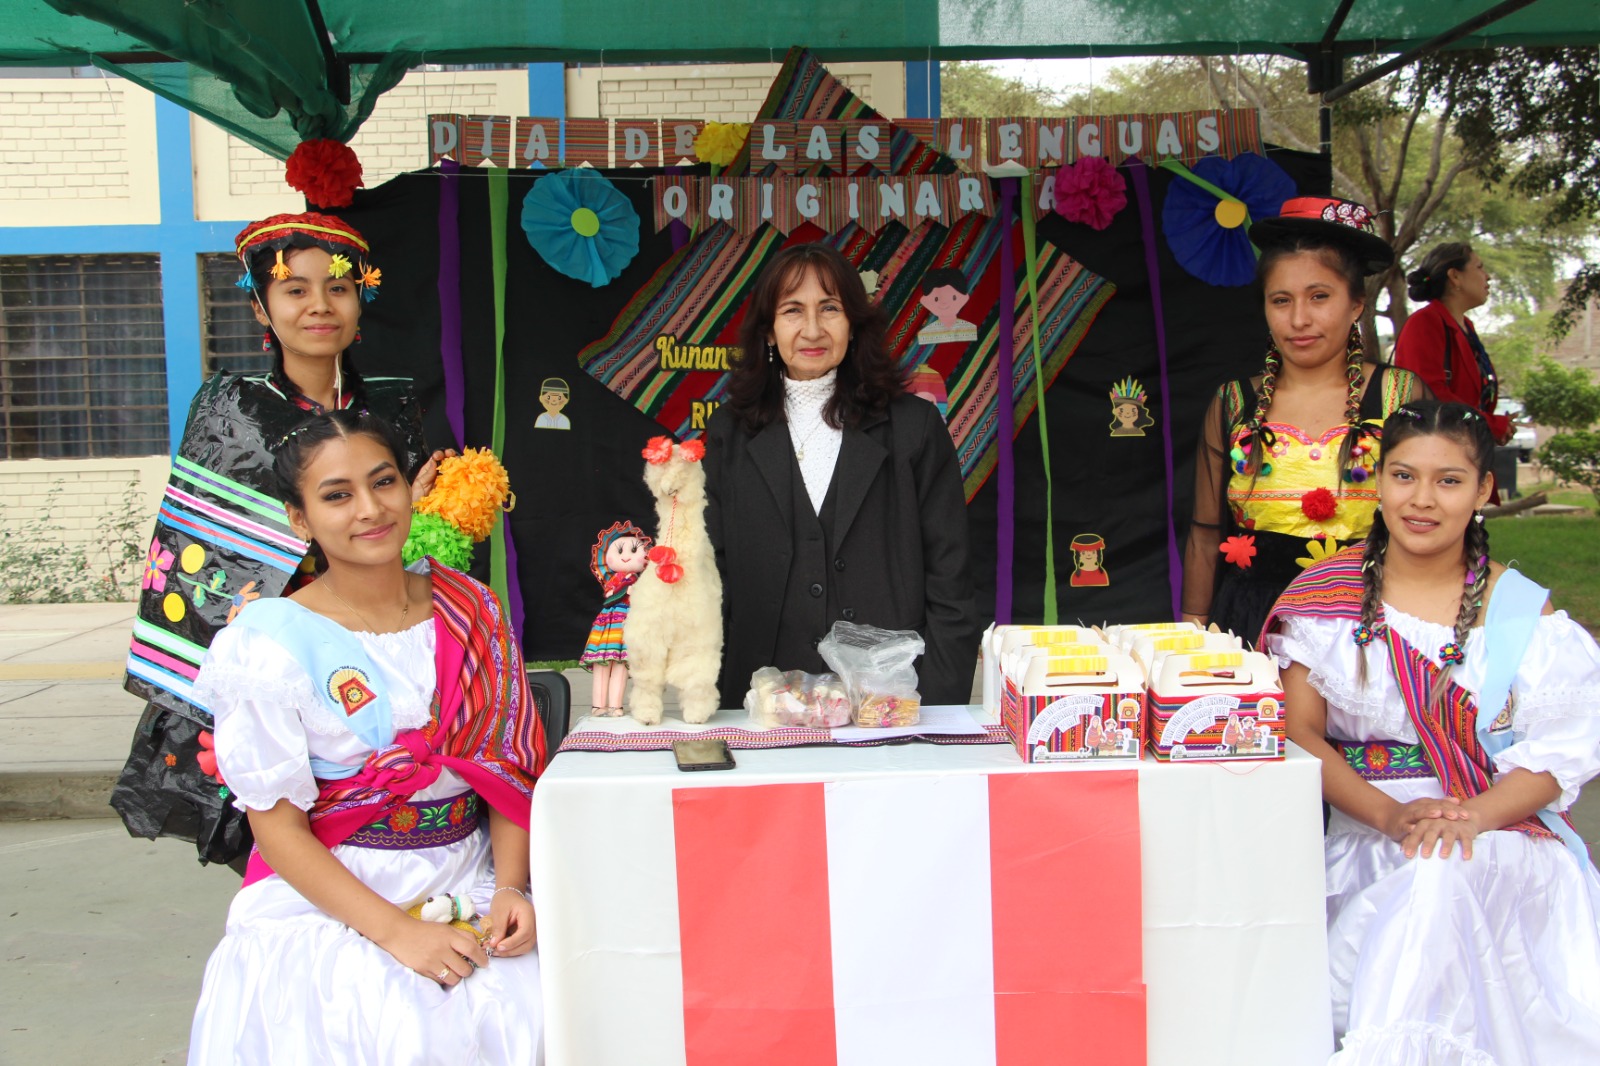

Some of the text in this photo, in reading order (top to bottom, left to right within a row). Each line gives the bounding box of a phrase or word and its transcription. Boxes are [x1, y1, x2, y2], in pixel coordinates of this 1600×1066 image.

[624, 124, 696, 161] DE
[761, 123, 880, 161] LAS
[948, 116, 1220, 160] LENGUAS
